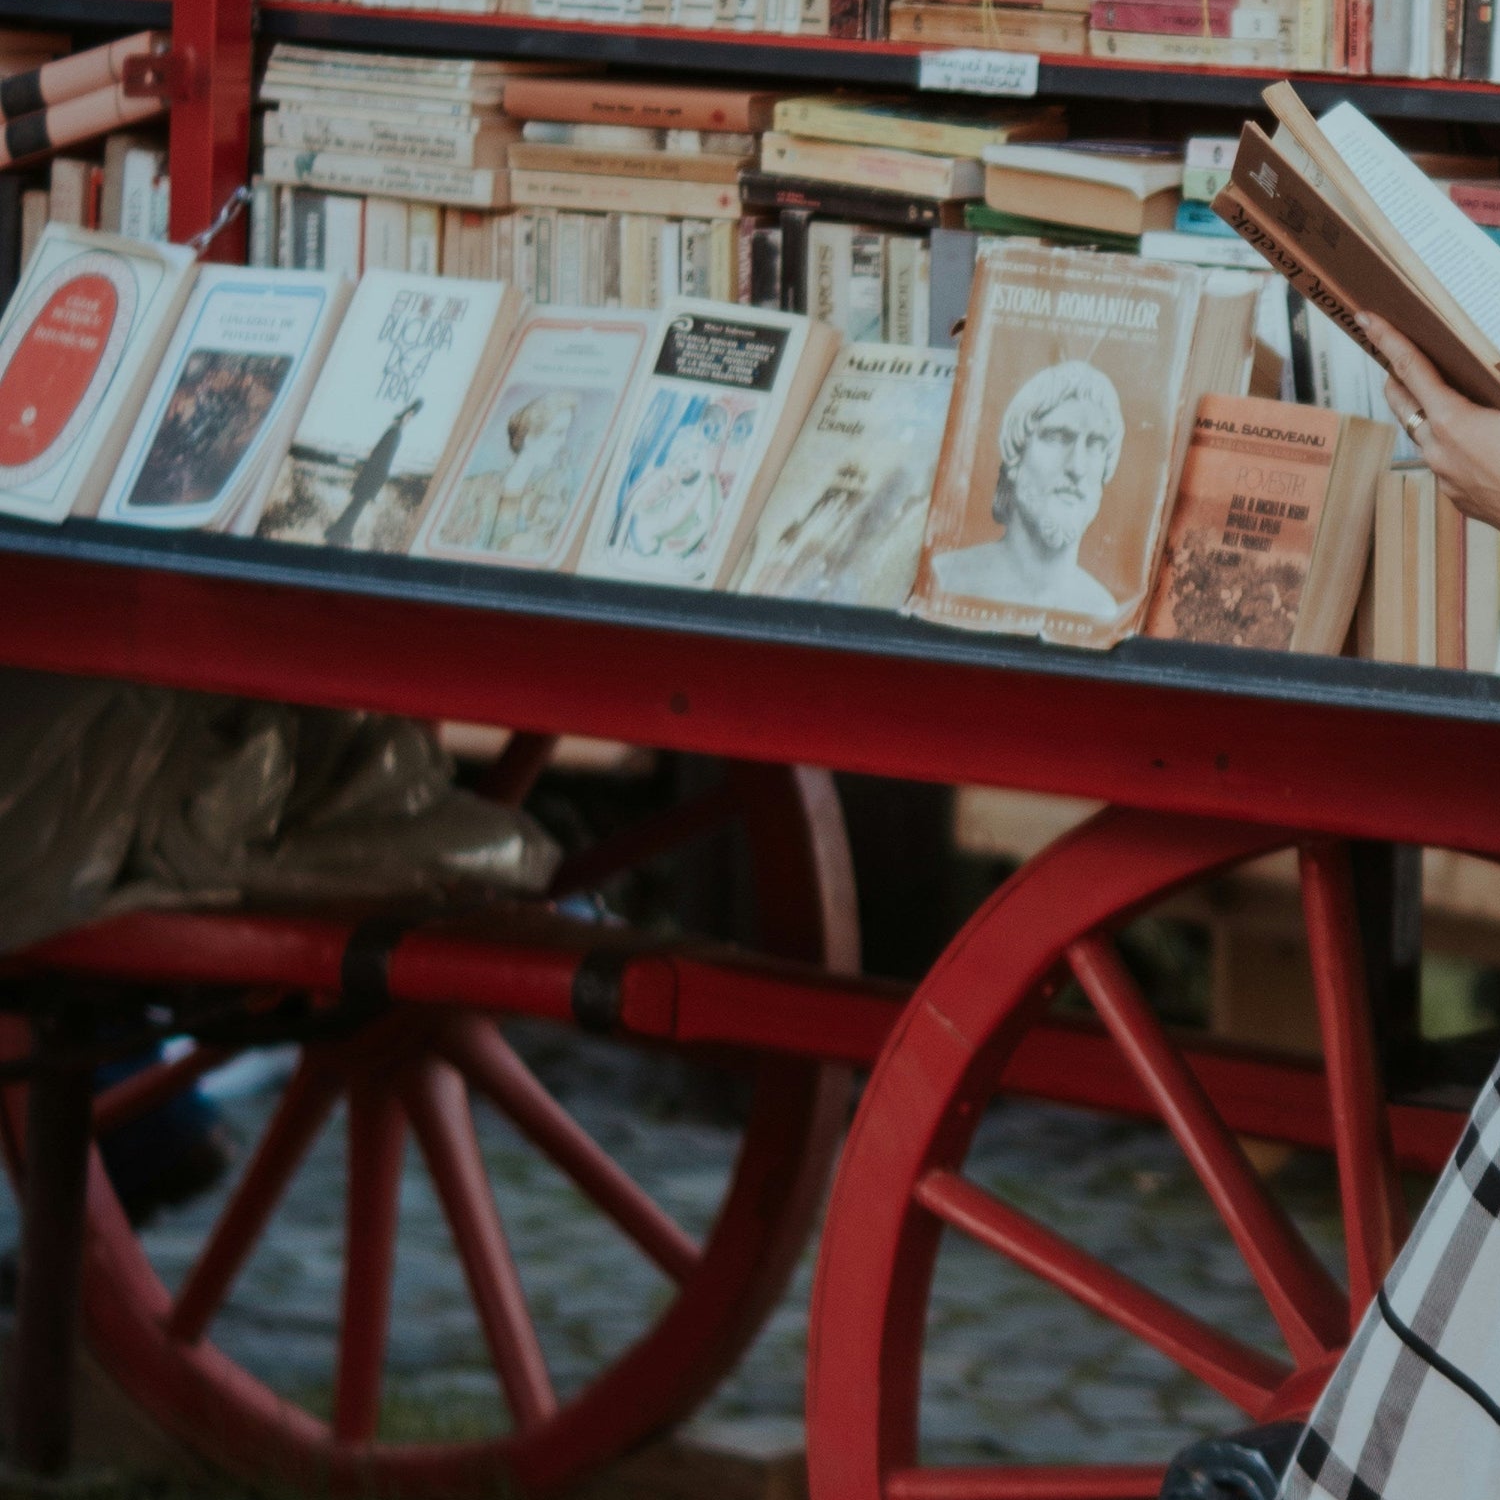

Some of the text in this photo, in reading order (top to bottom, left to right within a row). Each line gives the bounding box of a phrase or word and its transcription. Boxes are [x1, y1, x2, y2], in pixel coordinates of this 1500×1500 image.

[1231, 202, 1304, 280] levelek
[993, 282, 1160, 329] ISTORIA ROMÂNILOR
[847, 356, 957, 378] Marin Pre
[1196, 416, 1326, 447] MIHAIL SADOVEANU
